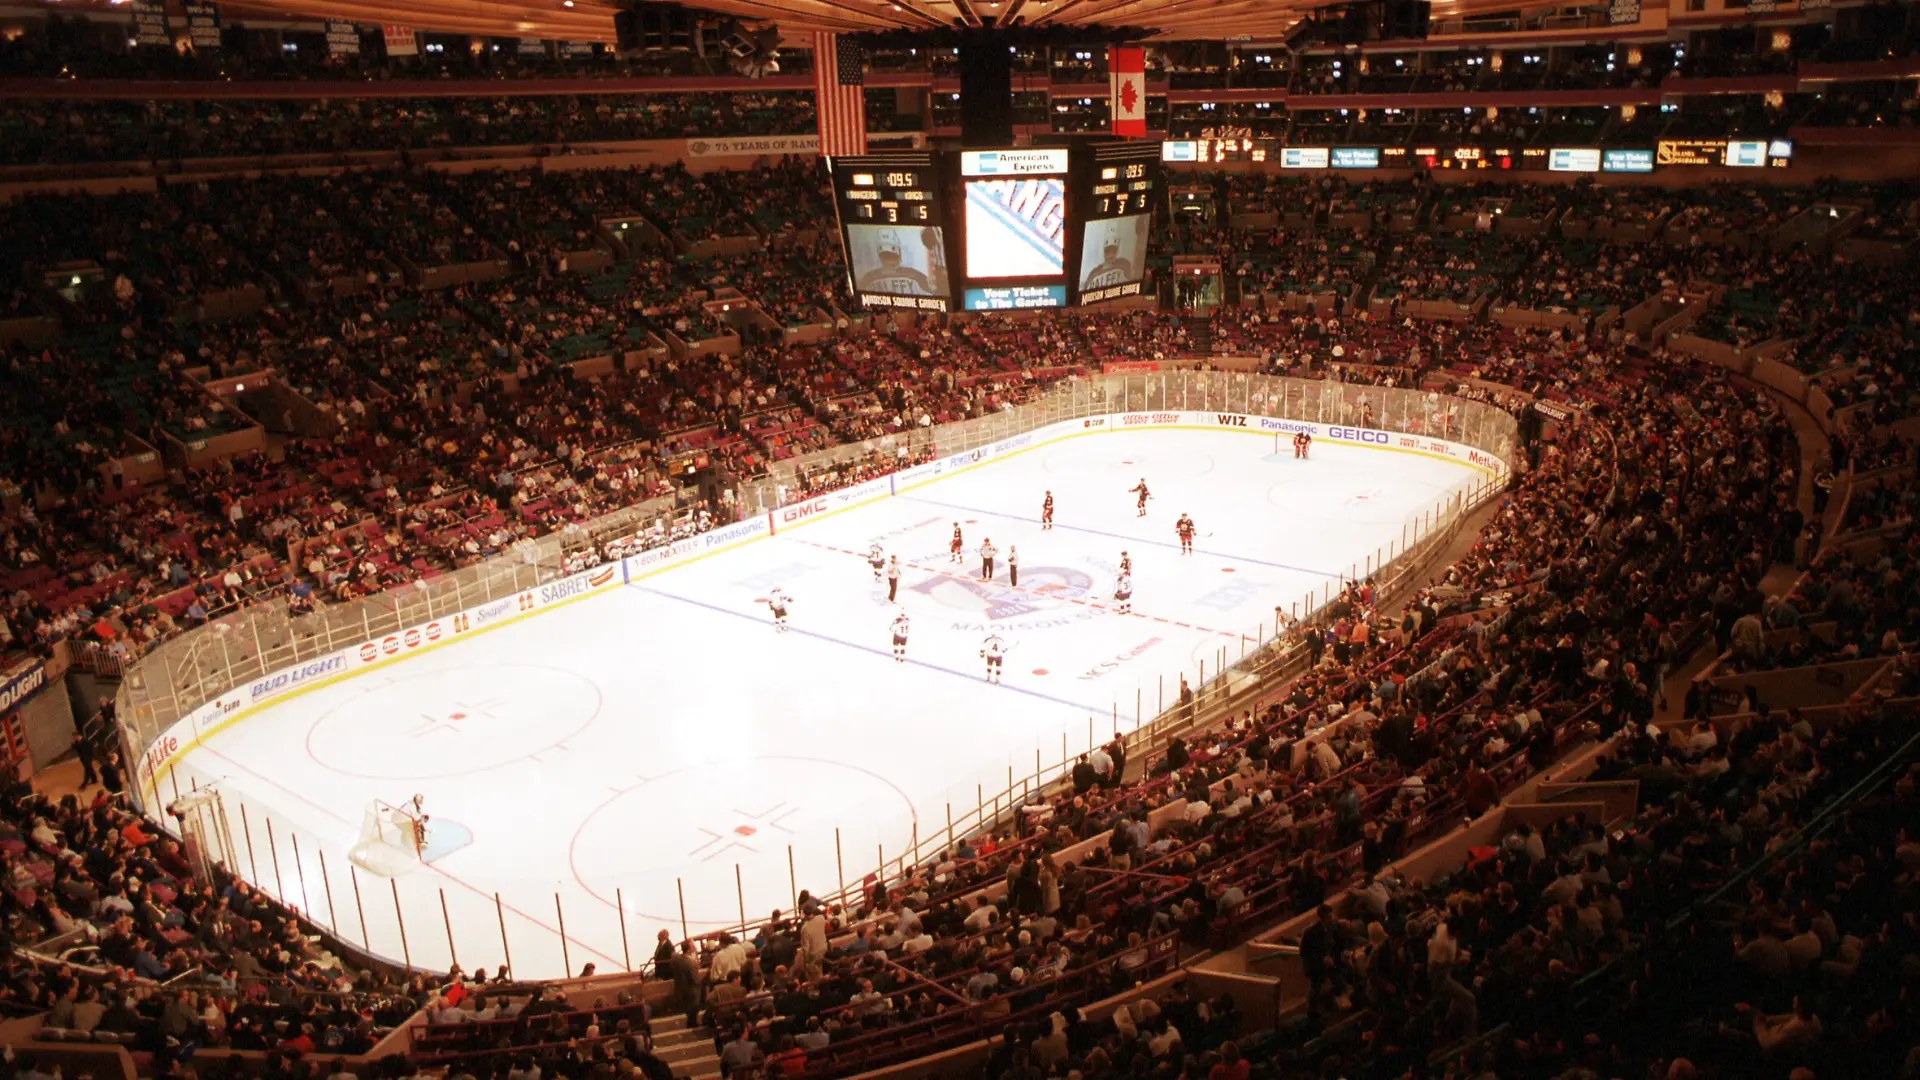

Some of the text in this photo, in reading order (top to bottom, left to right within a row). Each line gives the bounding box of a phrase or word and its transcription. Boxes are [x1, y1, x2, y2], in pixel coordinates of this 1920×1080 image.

[715, 143, 729, 152] 75
[732, 141, 771, 152] YEARS
[773, 140, 788, 150] OF
[999, 153, 1050, 162] American
[1013, 162, 1055, 172] Express
[1103, 198, 1109, 212] 7
[1117, 201, 1125, 214] 3
[1139, 194, 1146, 208] 5
[864, 204, 873, 218] 7
[889, 209, 897, 222] 3
[919, 205, 928, 219] 5
[983, 287, 1049, 298] Your Ticket
[861, 293, 947, 312] MADISON SQUARE GARDEN
[975, 297, 1057, 309] to The Garden
[1122, 412, 1180, 421] Office Office
[1196, 412, 1247, 427] THE WIZ
[1261, 418, 1318, 434] Panasonic
[1328, 426, 1389, 444] GEICO
[783, 498, 828, 523] GMC
[705, 520, 765, 547] Panasonic
[475, 599, 513, 623] Snapple
[950, 617, 1070, 632] MADISON
[991, 643, 998, 652] 4
[252, 655, 343, 697] BUD LIGHT
[11, 666, 45, 704] LIGHT
